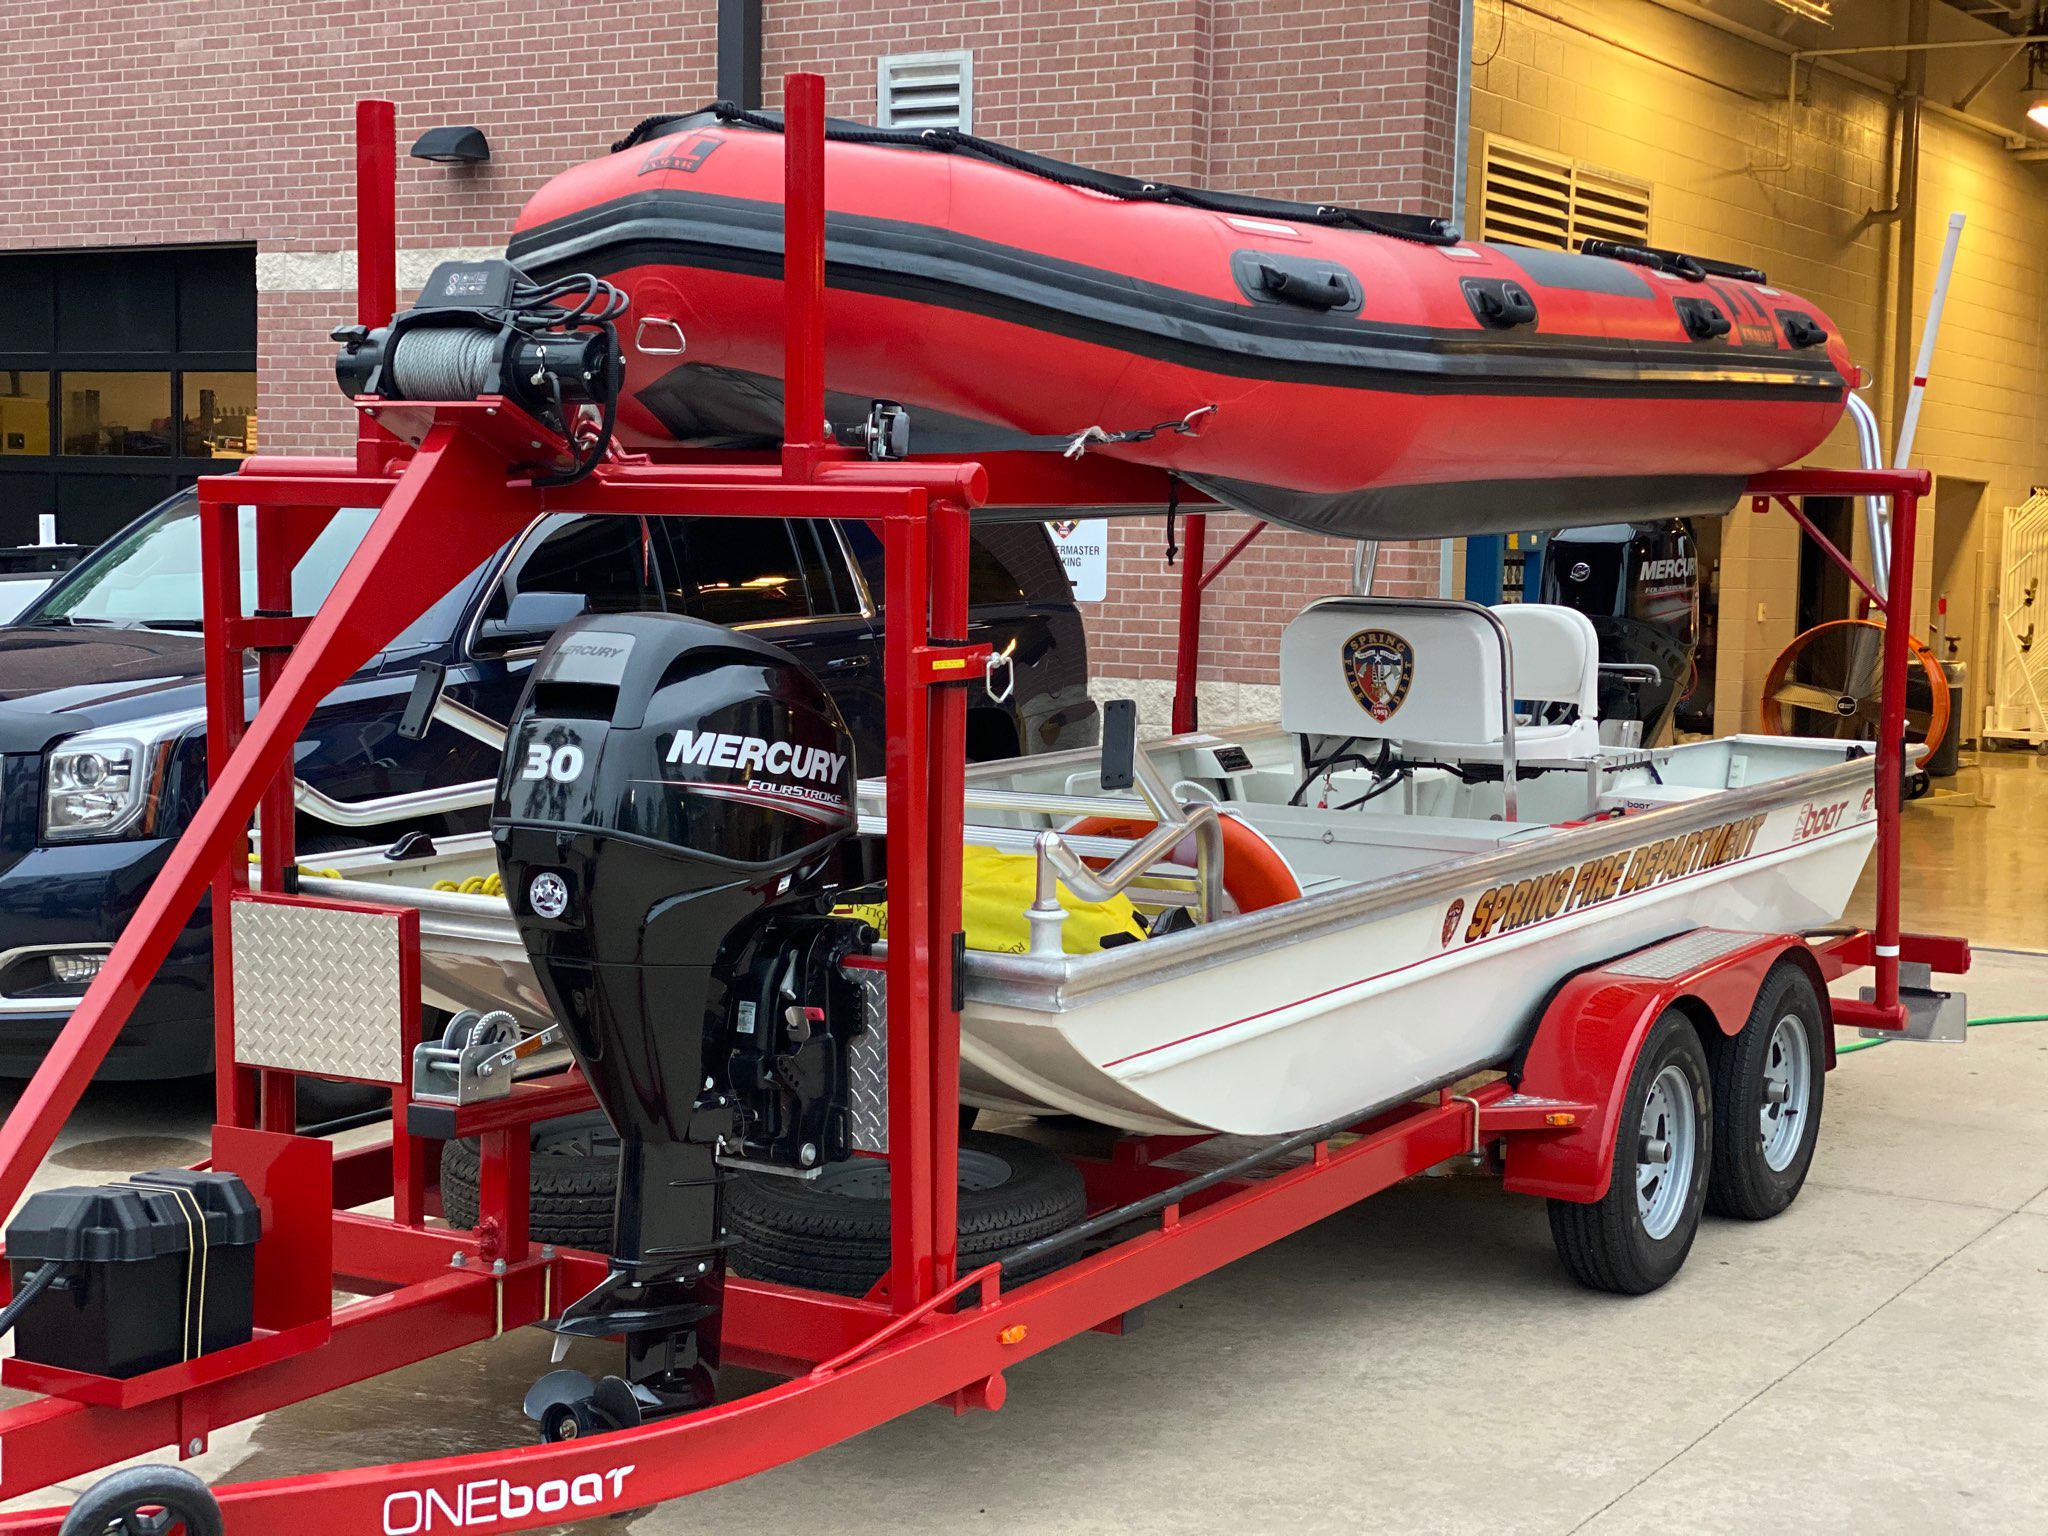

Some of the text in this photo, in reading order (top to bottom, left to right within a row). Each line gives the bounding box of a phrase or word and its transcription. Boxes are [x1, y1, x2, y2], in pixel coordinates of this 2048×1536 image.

[1062, 557, 1082, 567] KING
[1640, 557, 1697, 580] MERCUR
[1350, 633, 1406, 652] SPRING
[1344, 659, 1365, 700] FIRE
[1392, 660, 1413, 704] DEPT
[521, 743, 584, 783] 30
[666, 729, 847, 785] MERCURY
[1465, 866, 1576, 944] SPRING
[1564, 852, 1628, 914] FIRE
[1619, 812, 1768, 896] DEPARTMENT
